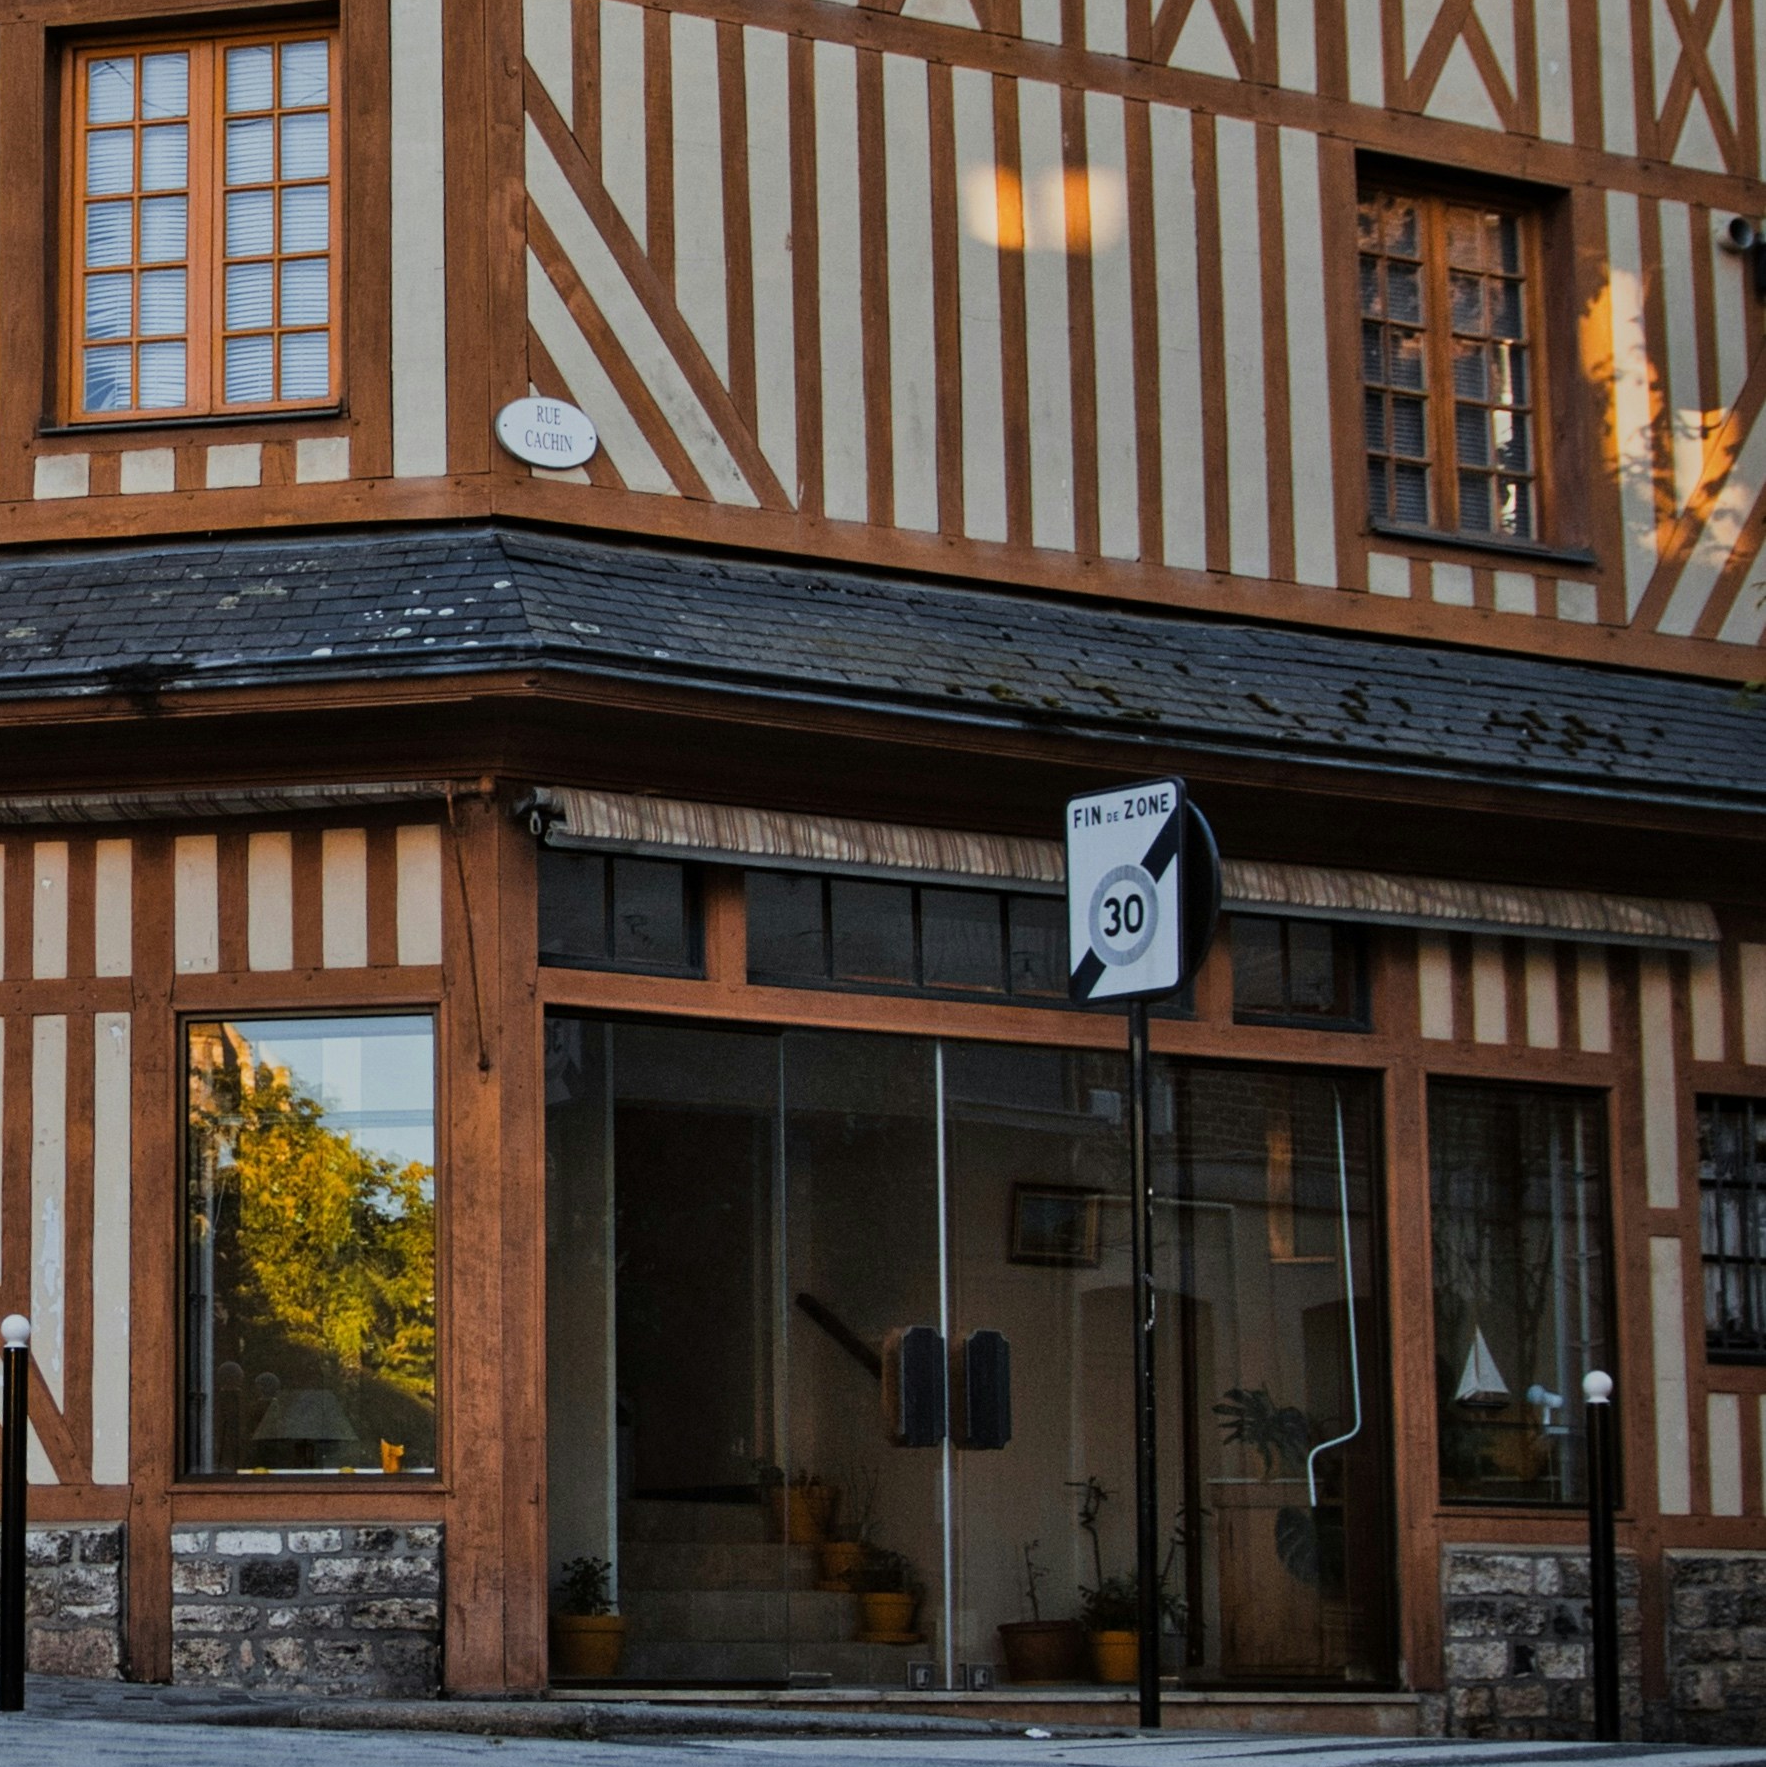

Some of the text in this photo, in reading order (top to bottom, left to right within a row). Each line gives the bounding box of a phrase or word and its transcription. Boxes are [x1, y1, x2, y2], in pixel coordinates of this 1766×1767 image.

[537, 405, 561, 425] RUE
[525, 429, 573, 452] CACHIN
[1074, 793, 1170, 828] FIN DE ZONE
[1104, 894, 1144, 937] 30
